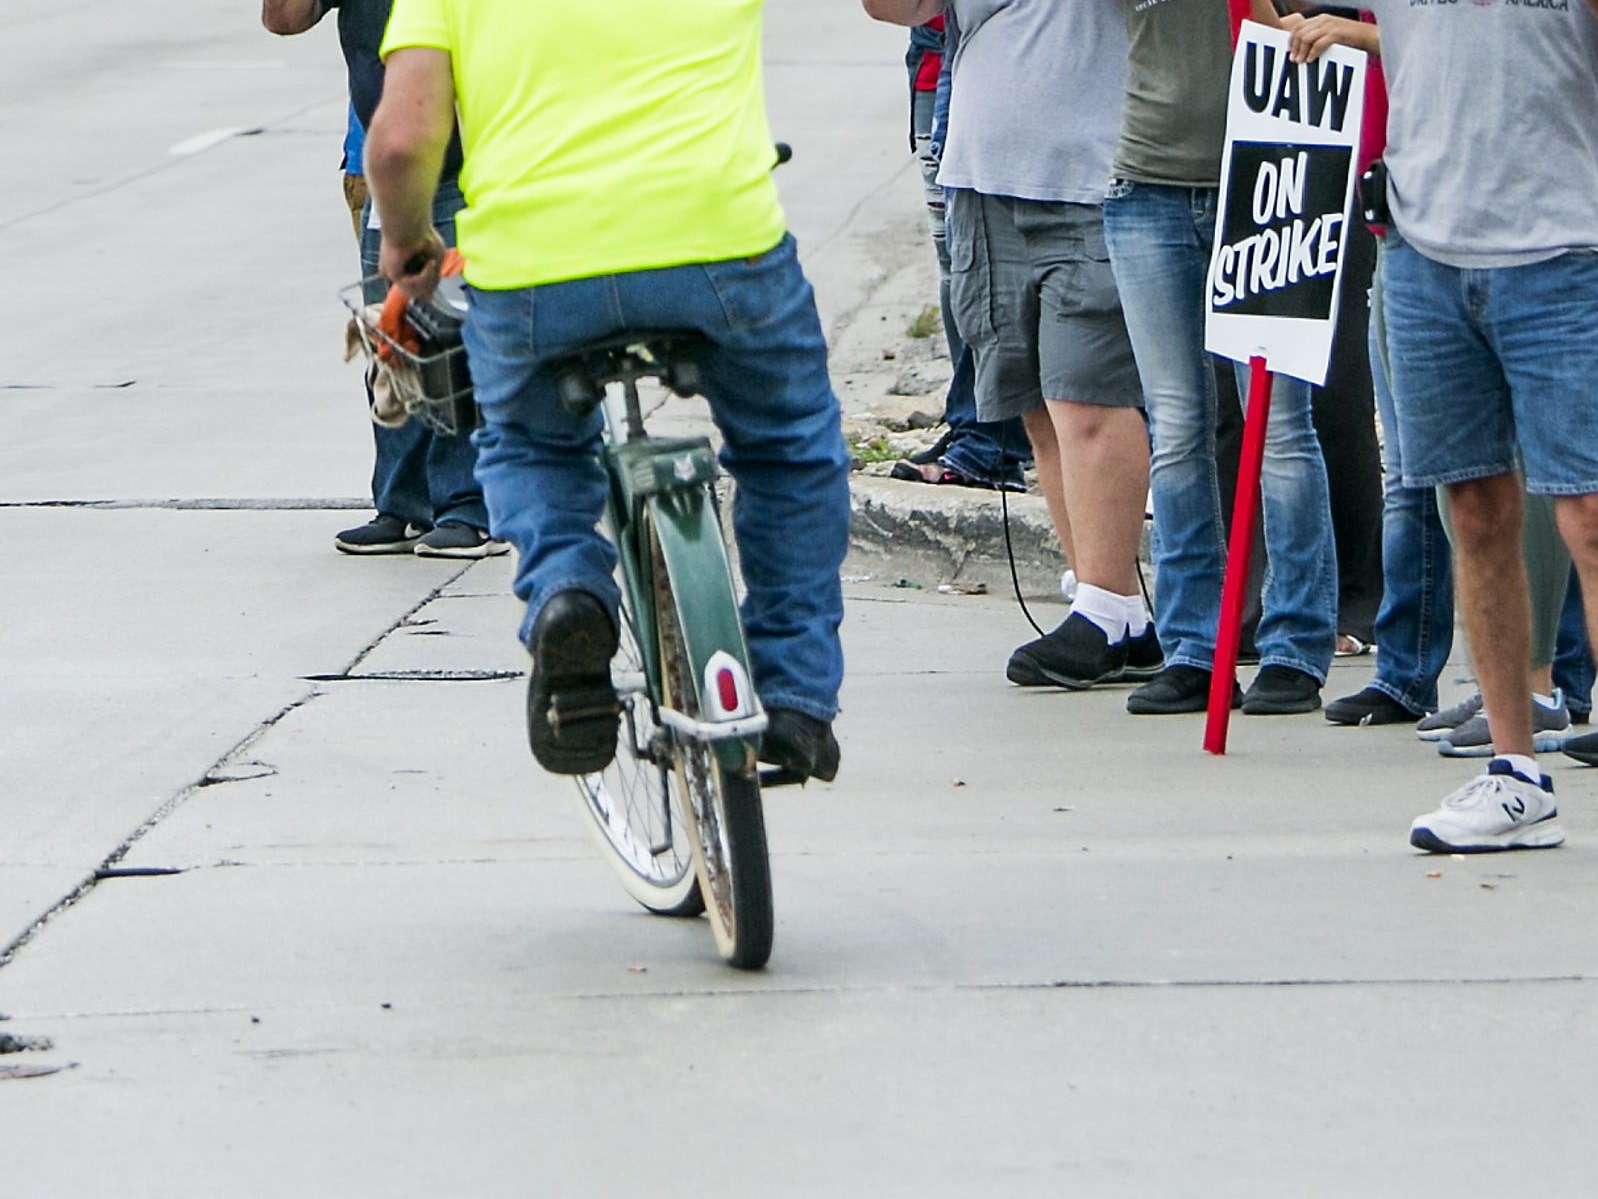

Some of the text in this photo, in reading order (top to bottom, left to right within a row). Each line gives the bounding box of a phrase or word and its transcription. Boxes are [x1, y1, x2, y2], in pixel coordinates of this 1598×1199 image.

[1244, 42, 1354, 132] UAW
[1252, 152, 1307, 225] ON
[1213, 213, 1343, 306] STRIKE
